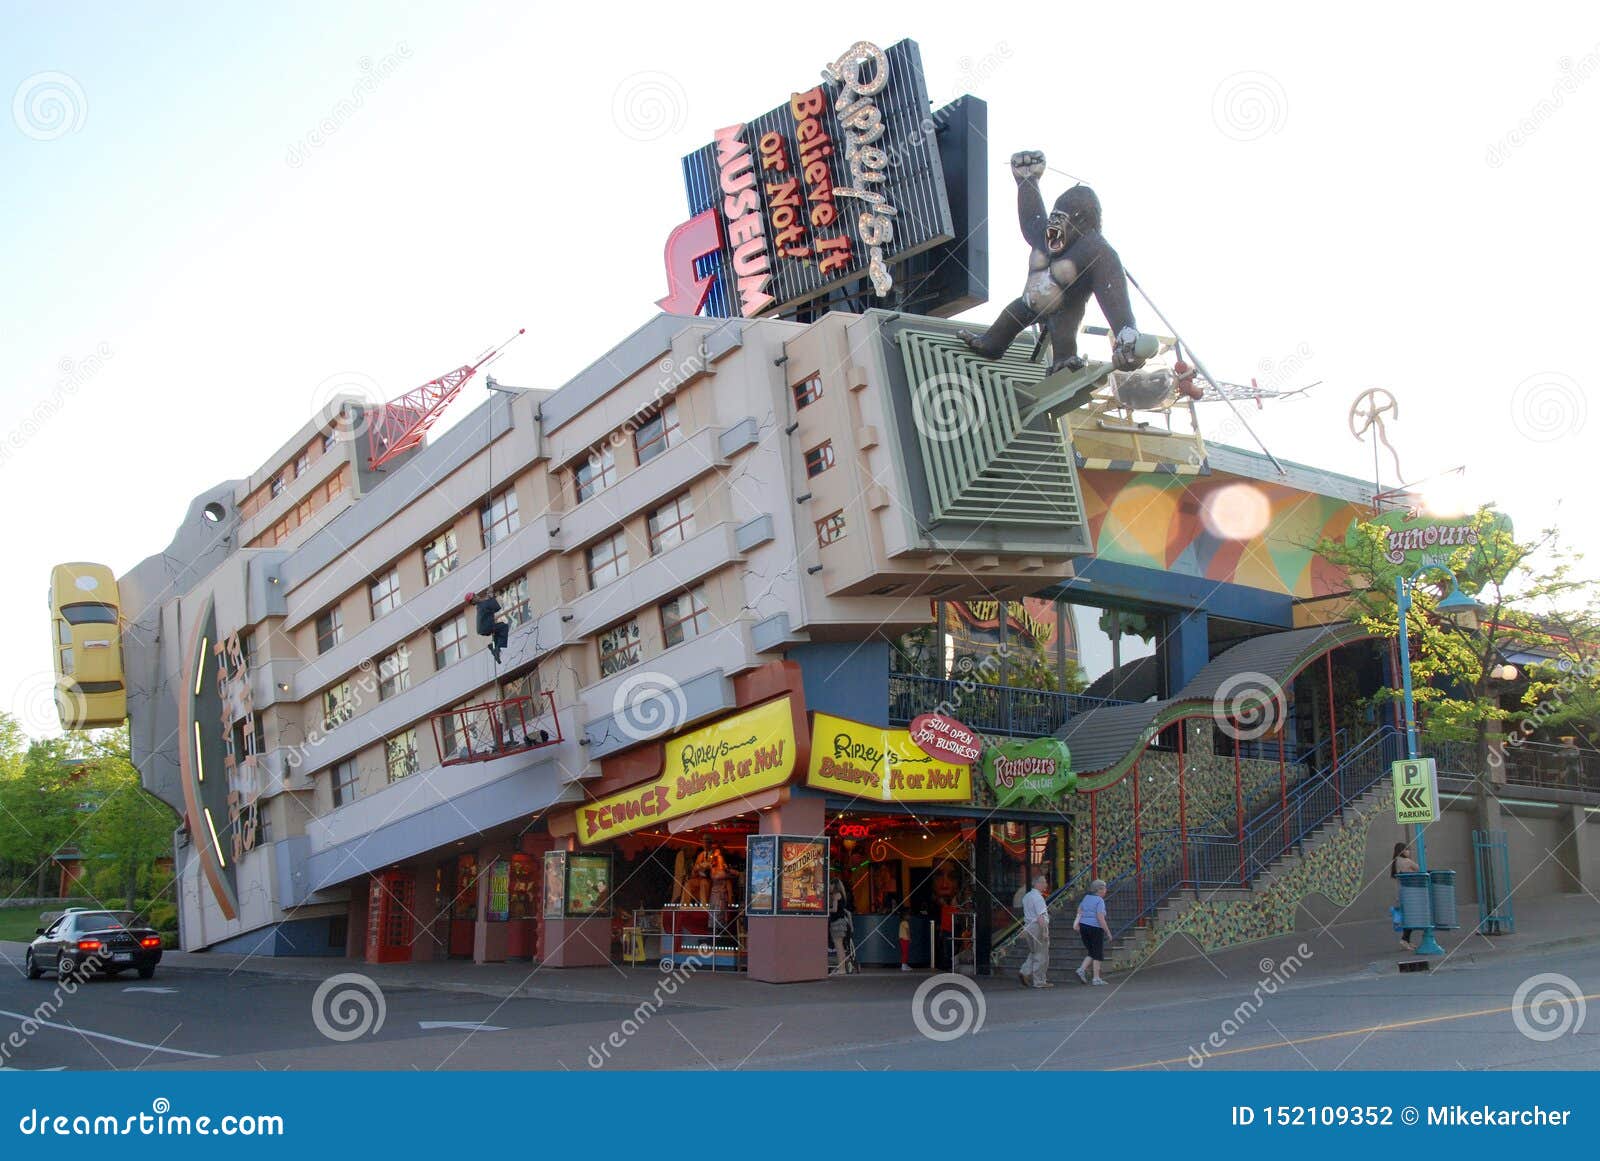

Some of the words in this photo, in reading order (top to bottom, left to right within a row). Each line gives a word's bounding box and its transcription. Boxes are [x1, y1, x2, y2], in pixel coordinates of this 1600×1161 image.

[759, 131, 788, 173] or
[791, 86, 839, 228] Believe
[714, 122, 775, 317] MUSEUM
[765, 177, 814, 261] Not!
[814, 235, 852, 275] It
[918, 728, 935, 744] FOR
[935, 737, 979, 760] BUSINESS!
[928, 718, 950, 733] STILL
[950, 728, 973, 744] OPEN
[676, 767, 720, 799] Believe
[723, 758, 736, 784] It
[737, 757, 752, 779] or
[753, 738, 784, 774] Not!
[819, 757, 879, 787] Believe
[888, 769, 904, 789] It
[907, 773, 925, 788] or
[926, 767, 961, 789] Not!
[993, 754, 1056, 789] Rumours
[1404, 764, 1418, 785] P
[838, 824, 870, 837] OPEN
[1398, 809, 1431, 819] PARKING
